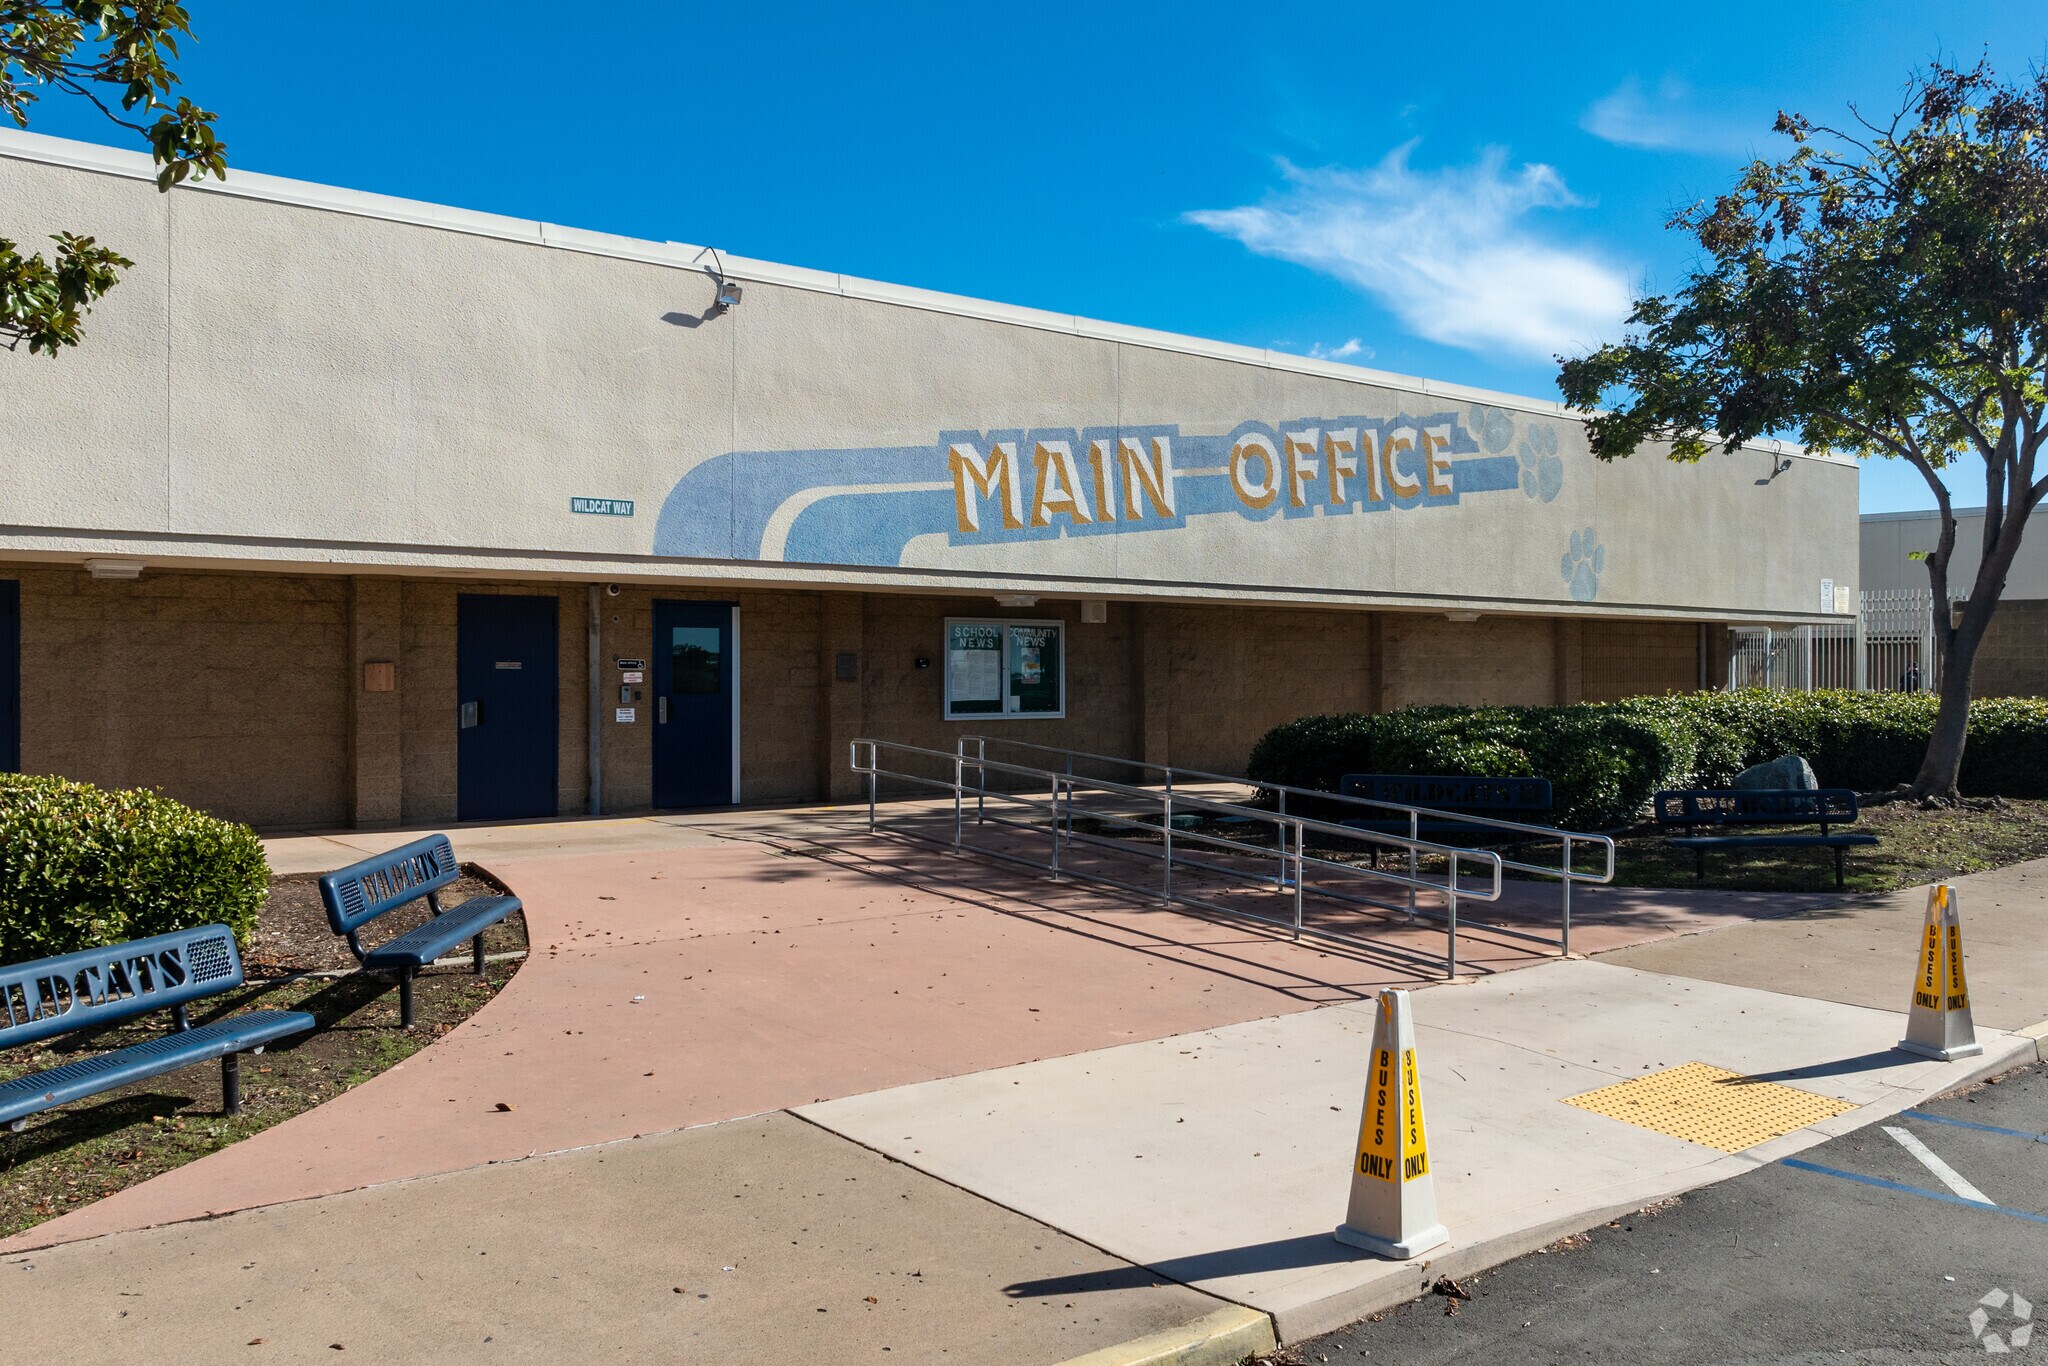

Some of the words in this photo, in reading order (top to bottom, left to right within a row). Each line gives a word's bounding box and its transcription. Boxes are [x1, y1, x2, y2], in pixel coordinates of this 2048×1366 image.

[948, 436, 1176, 533] MAIN
[1230, 424, 1454, 510] OFFICE
[573, 498, 611, 514] WILDCAT
[612, 501, 632, 515] WAY
[954, 627, 999, 637] SCHOOL
[959, 638, 994, 648] NEWS
[1010, 627, 1057, 639] COMMUNITY
[1016, 637, 1046, 647] NEWS
[361, 850, 440, 906] WILDCATS
[1925, 924, 1937, 988] BUSES
[1950, 925, 1959, 989] BUSES
[1916, 991, 1939, 1010] ONLY
[1947, 994, 1966, 1011] ONLY
[1374, 1050, 1389, 1146] BUSES
[1405, 1049, 1417, 1145] BUSES
[1361, 1152, 1393, 1180] ONLY
[1405, 1152, 1426, 1180] ONLY
